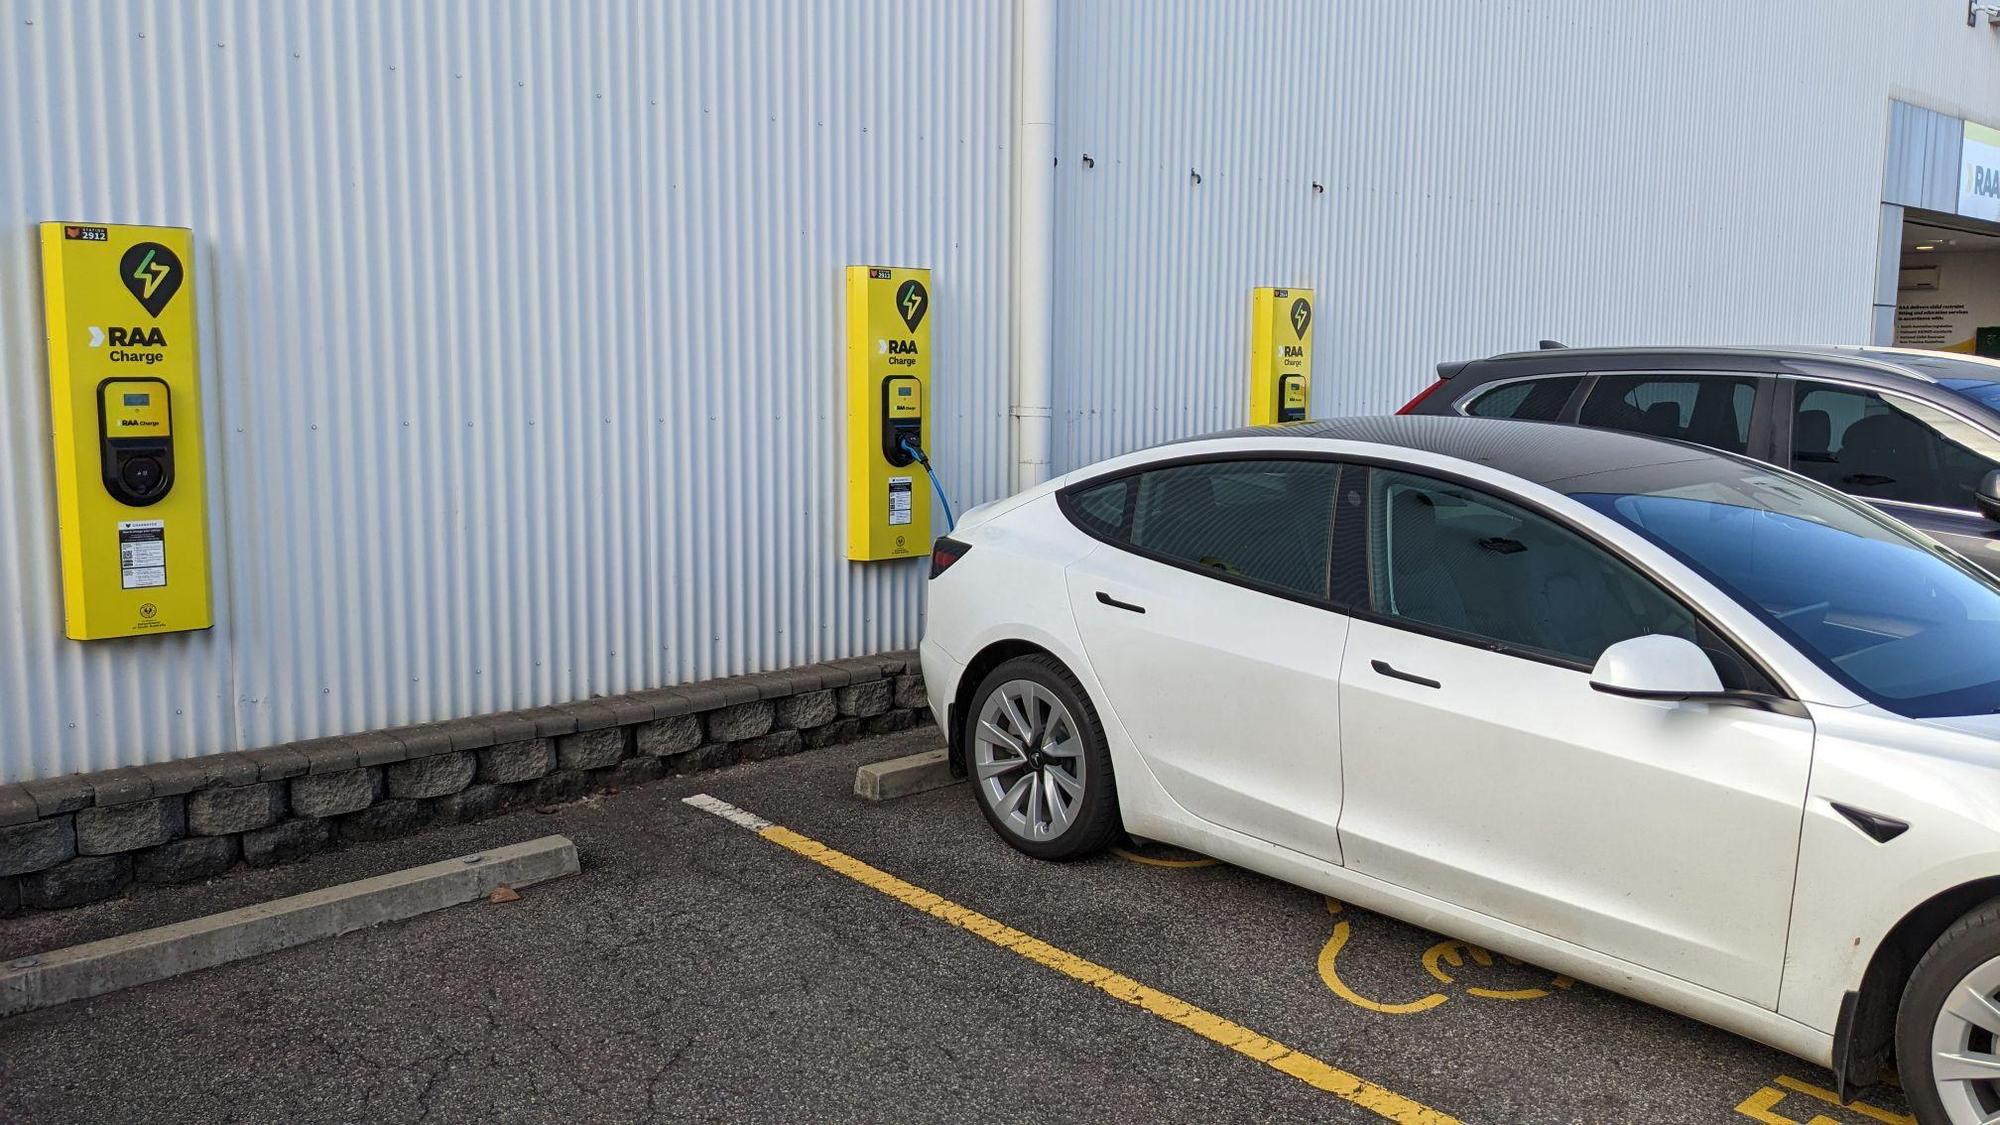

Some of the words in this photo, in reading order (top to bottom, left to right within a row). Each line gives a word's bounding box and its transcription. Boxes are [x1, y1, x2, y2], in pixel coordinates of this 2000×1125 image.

[1974, 165, 2000, 199] RAA
[82, 231, 106, 240] 2912
[108, 327, 167, 347] RAA
[888, 340, 918, 354] RAA
[1284, 345, 1303, 357] RAA
[109, 350, 163, 364] Charge
[888, 356, 916, 367] Charge
[1284, 358, 1302, 367] Charge
